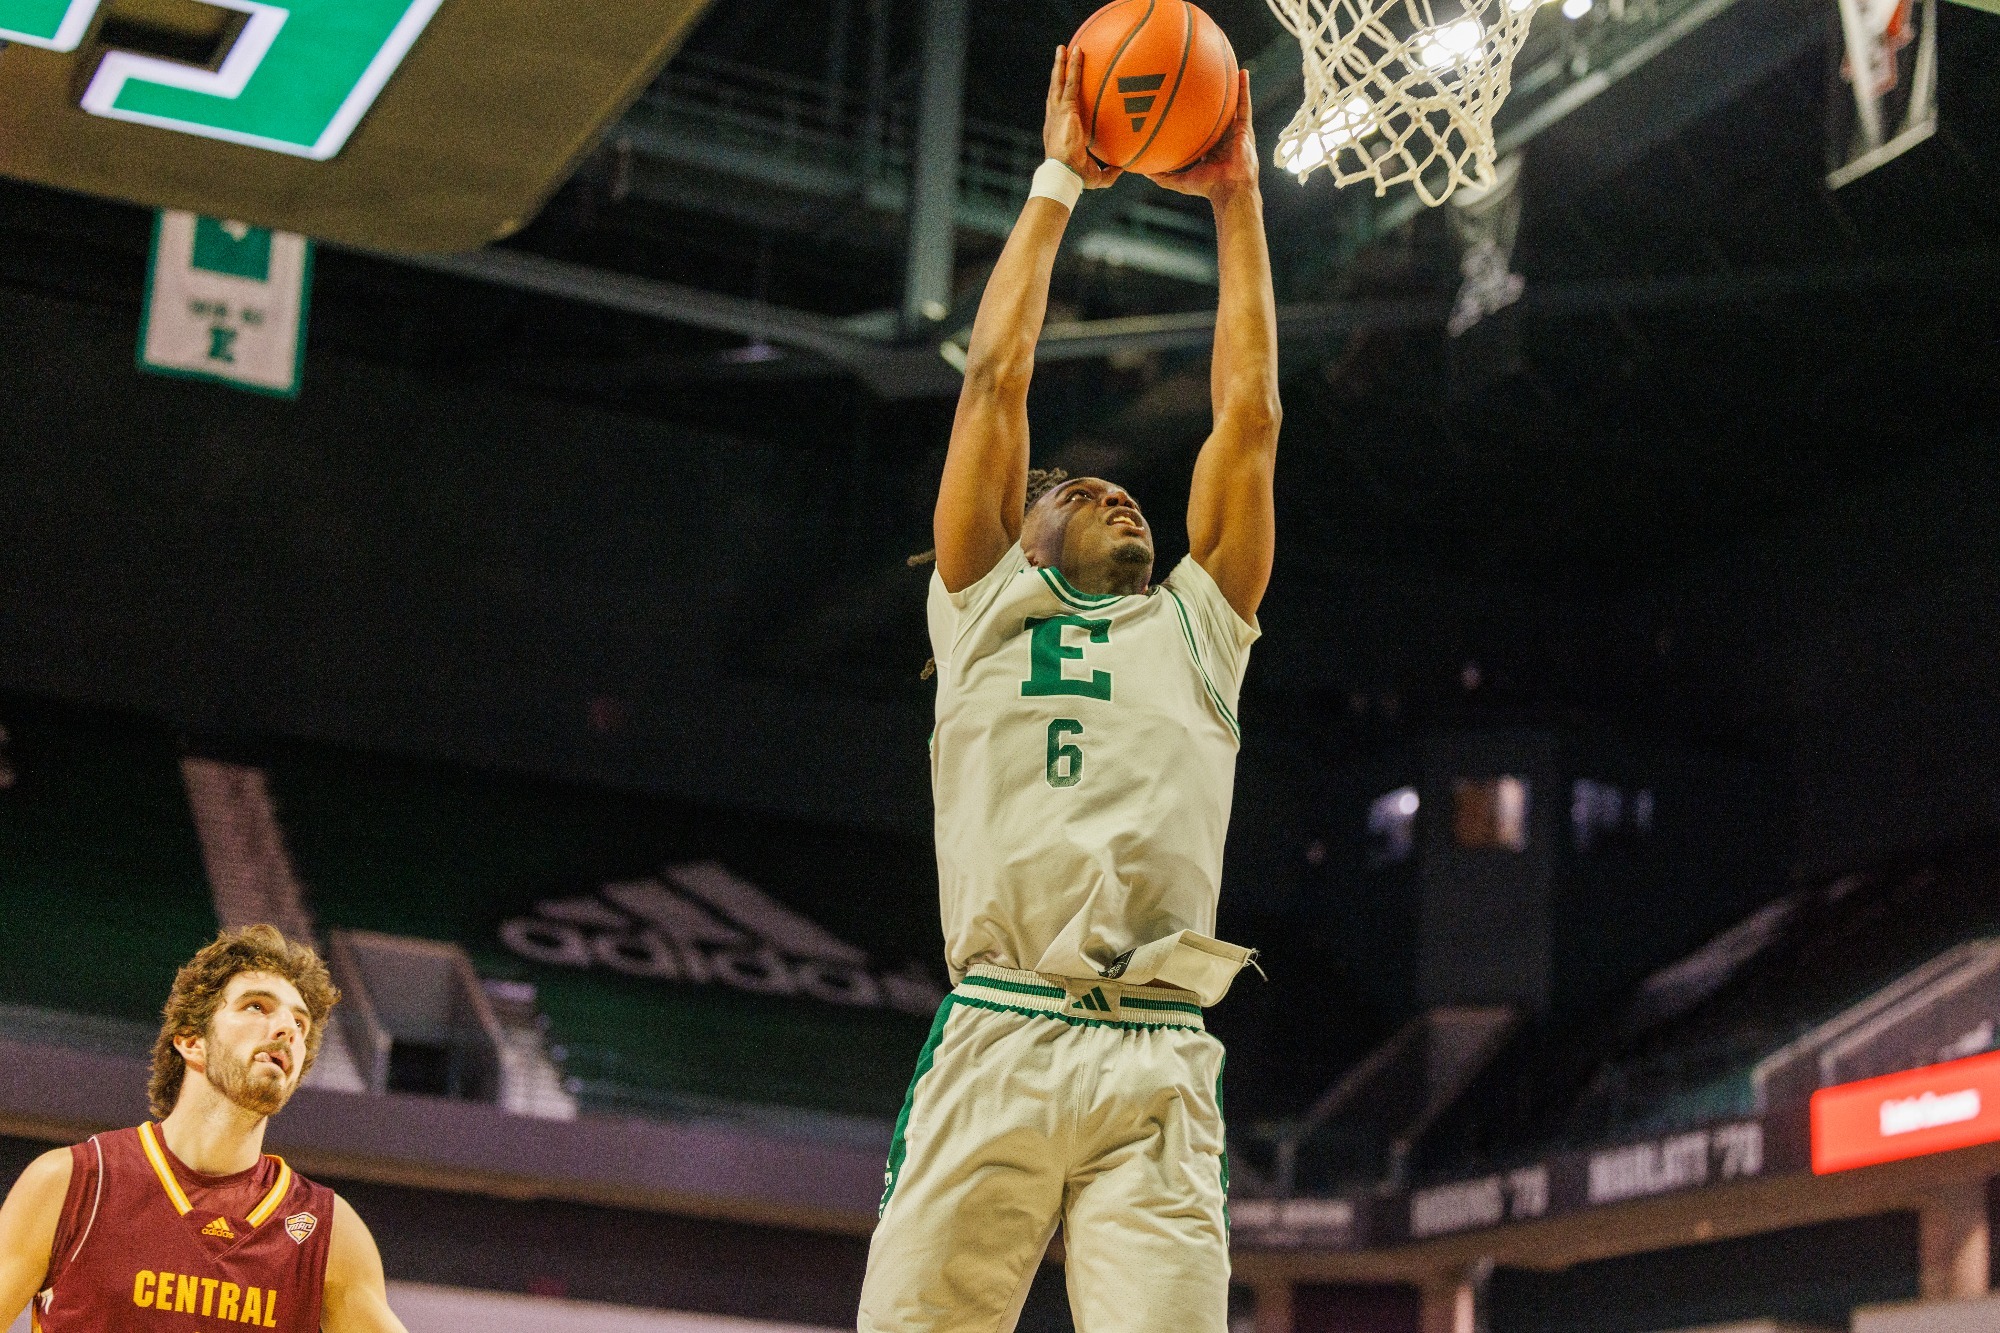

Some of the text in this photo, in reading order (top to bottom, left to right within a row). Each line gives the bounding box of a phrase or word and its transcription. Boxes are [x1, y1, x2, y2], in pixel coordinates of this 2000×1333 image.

[1021, 615, 1114, 702] E
[1045, 718, 1084, 788] 6
[201, 1228, 235, 1239] adidas
[288, 1222, 314, 1232] MAC
[133, 1270, 277, 1328] CENTRAL
